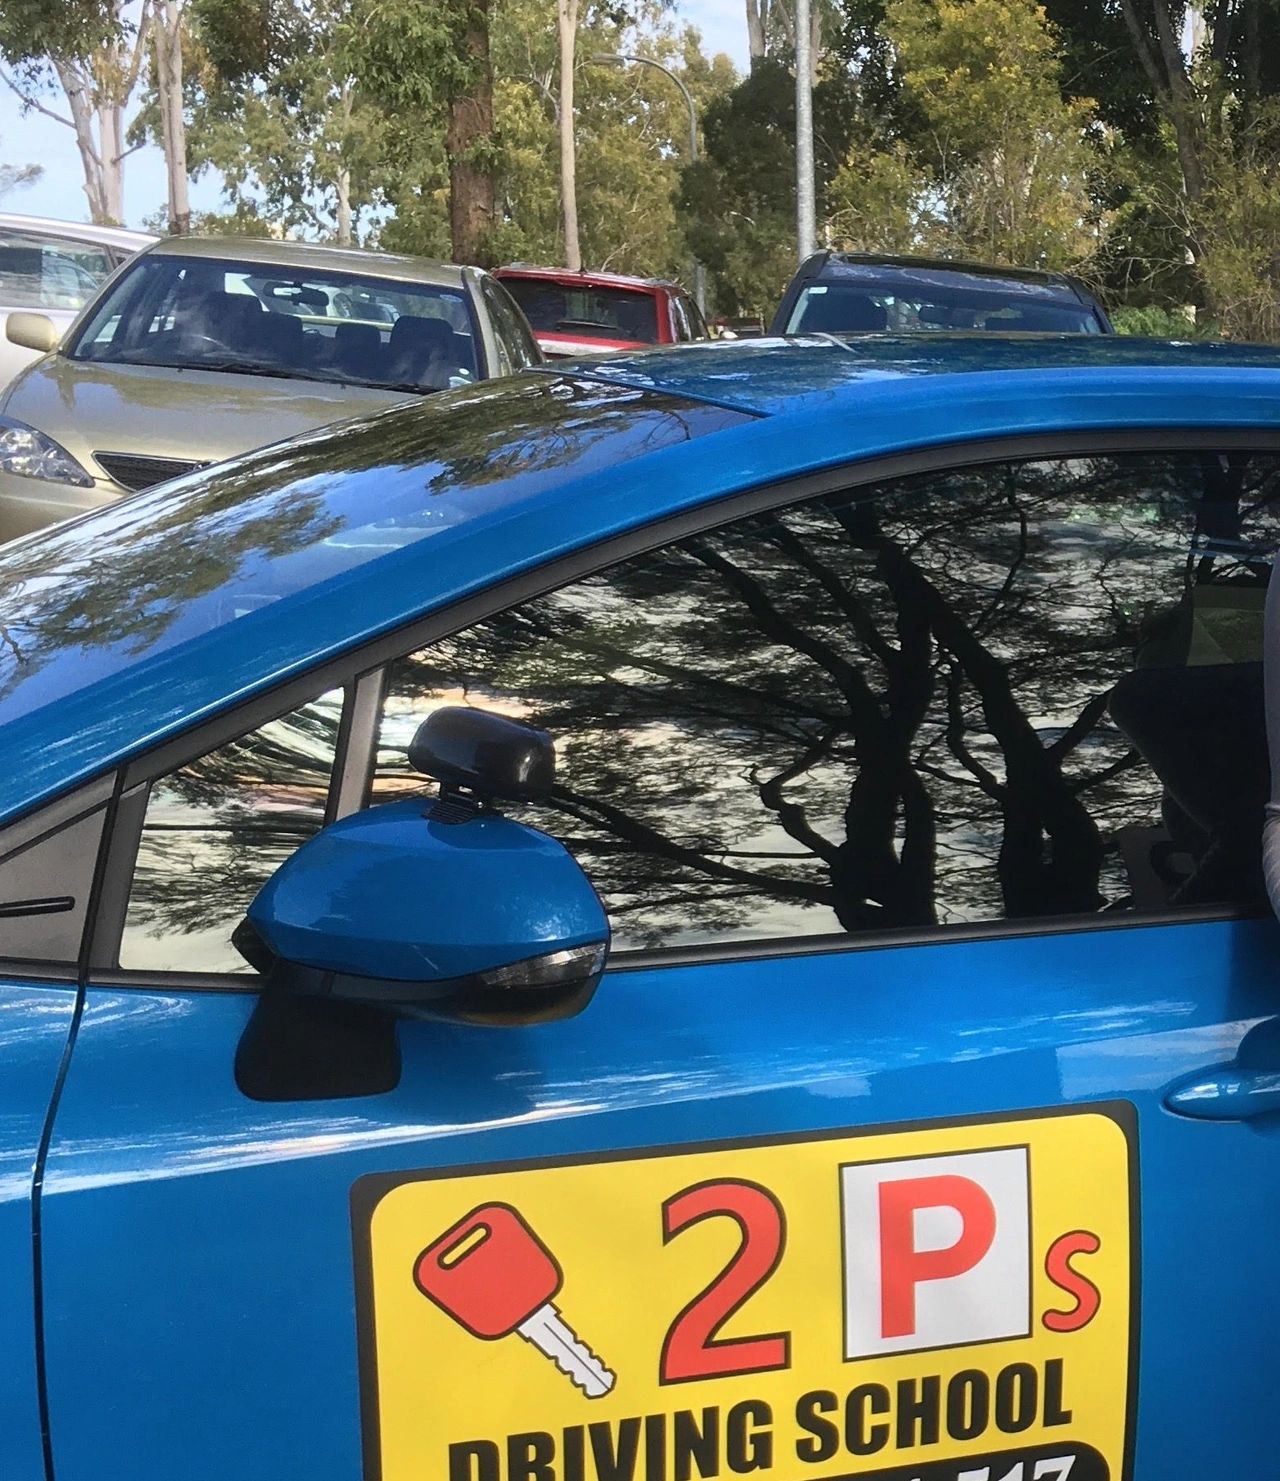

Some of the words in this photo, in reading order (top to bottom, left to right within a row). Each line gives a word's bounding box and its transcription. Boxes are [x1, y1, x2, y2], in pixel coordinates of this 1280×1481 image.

[659, 1177, 792, 1386] 2
[448, 1399, 774, 1481] DRIVING
[795, 1357, 1073, 1463] SCHOOL
